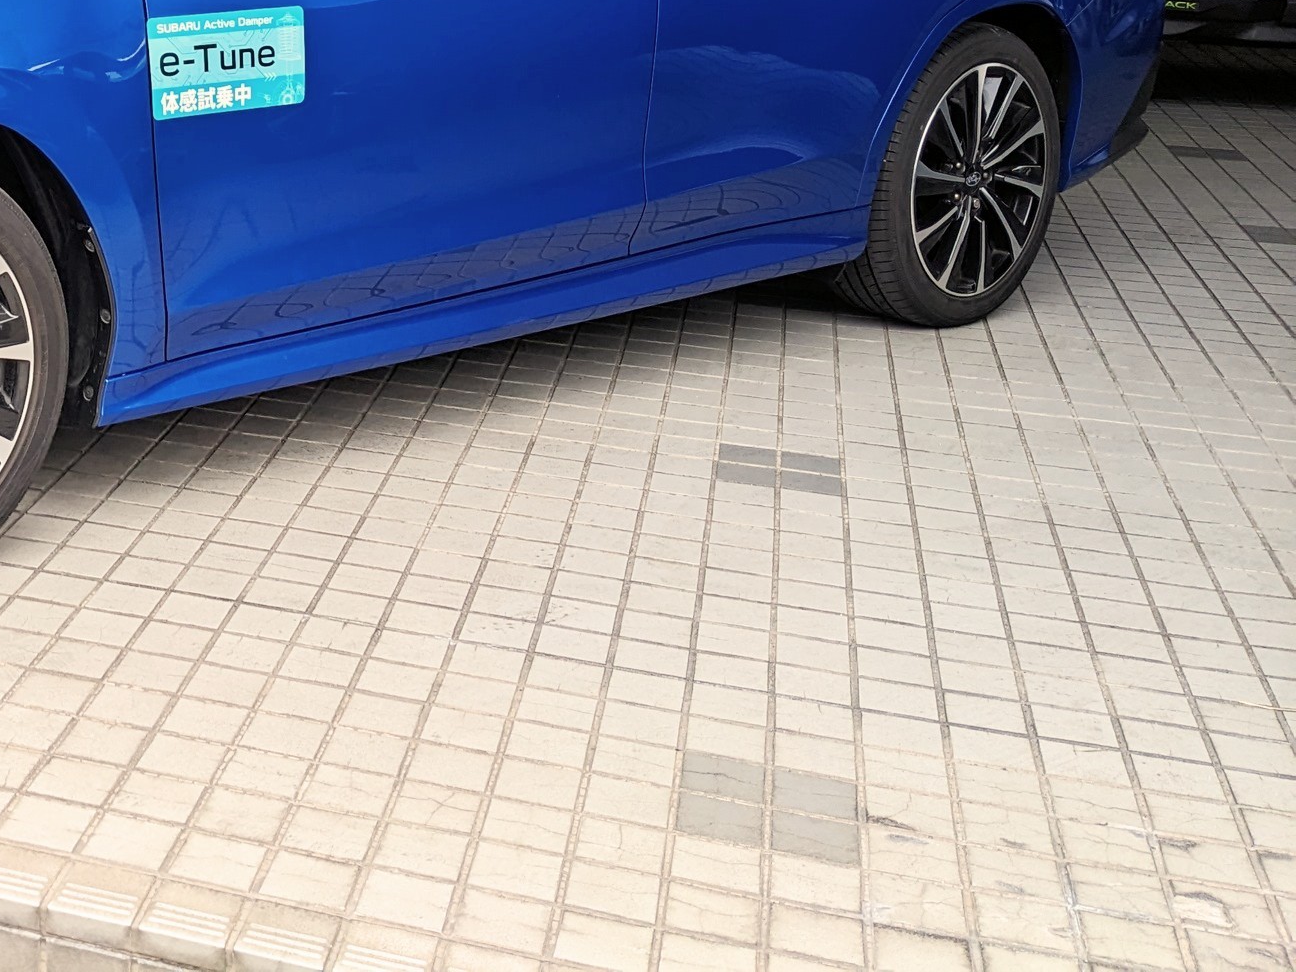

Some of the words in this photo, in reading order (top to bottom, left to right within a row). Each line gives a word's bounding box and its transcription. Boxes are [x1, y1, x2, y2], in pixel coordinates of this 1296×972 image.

[156, 21, 201, 34] SUBARU
[203, 18, 236, 30] Active
[238, 15, 274, 28] Damper
[159, 43, 276, 77] e-Tune
[160, 83, 252, 116] 体感試乗中
